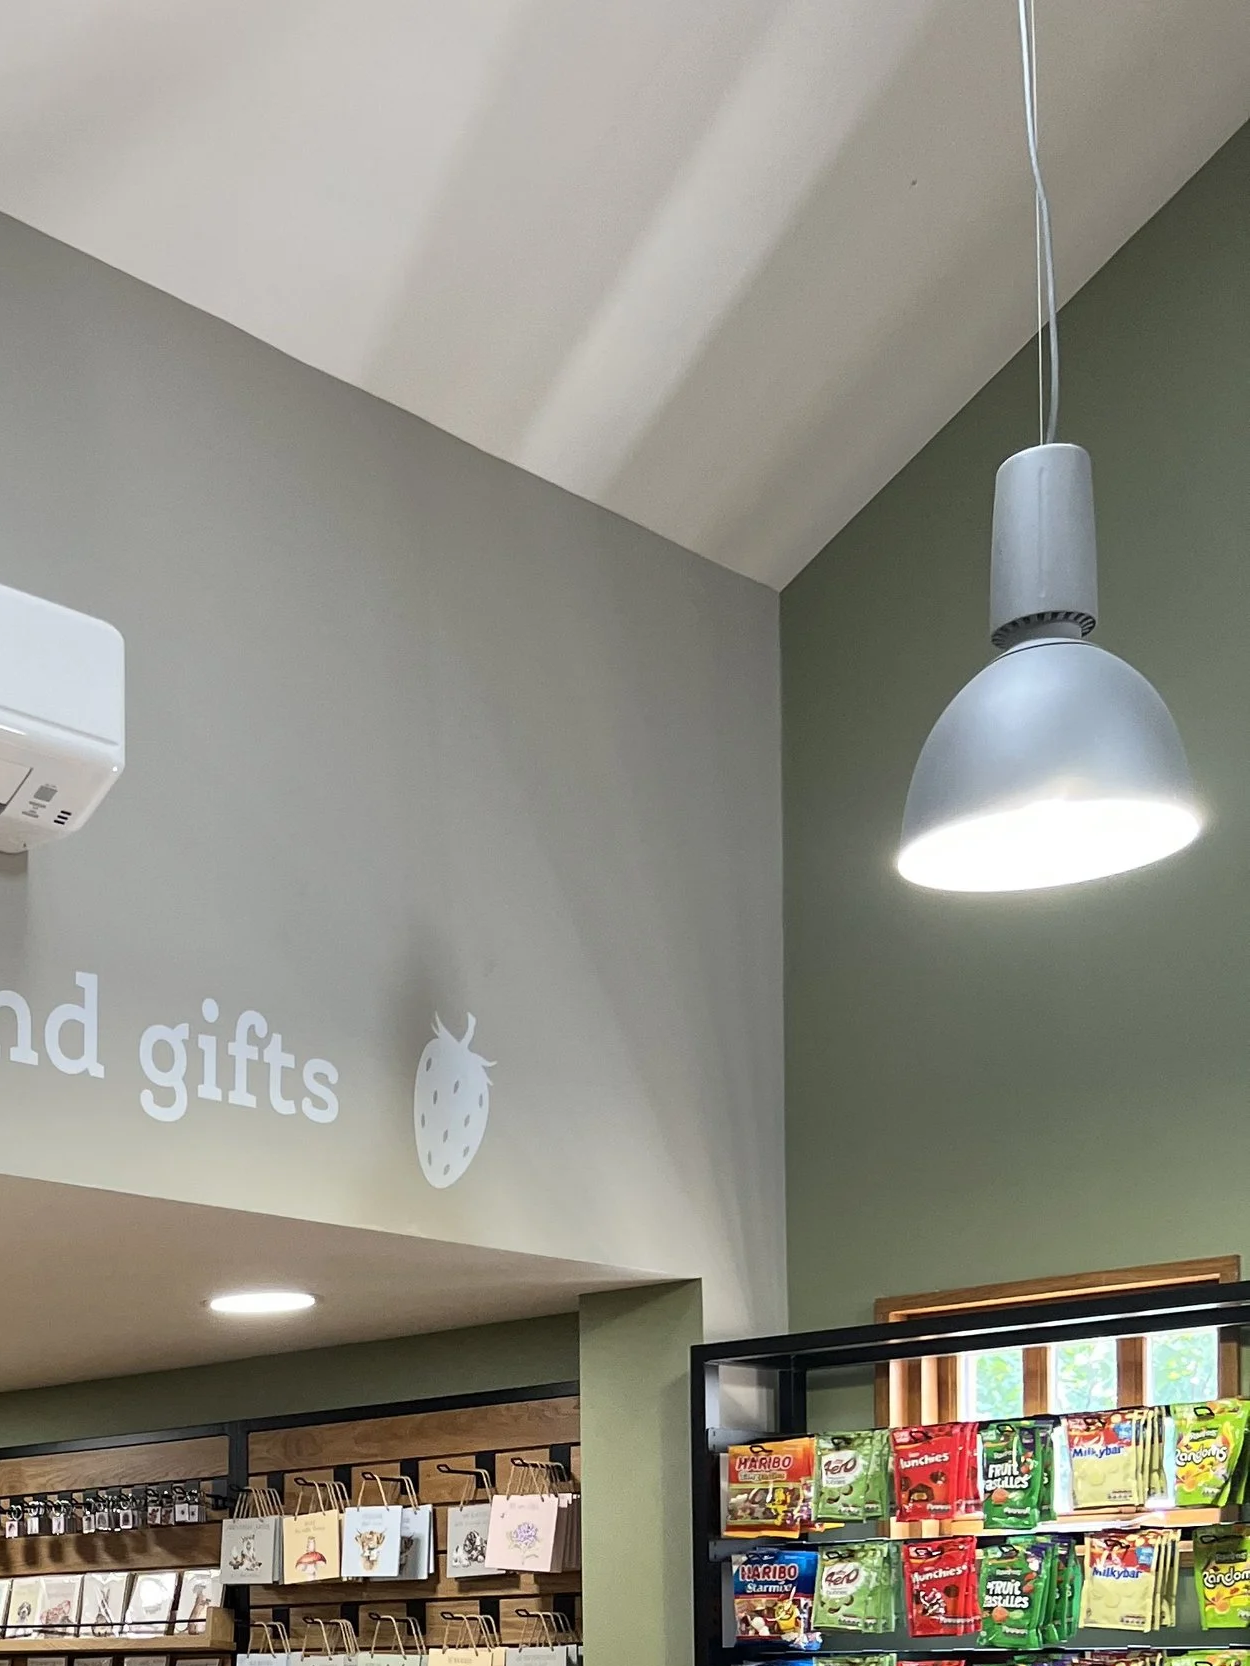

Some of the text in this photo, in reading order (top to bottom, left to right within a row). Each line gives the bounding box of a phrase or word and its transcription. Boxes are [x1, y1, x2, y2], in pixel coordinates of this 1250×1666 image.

[139, 998, 340, 1124] gifts
[735, 1455, 793, 1472] HARIBO
[738, 1563, 799, 1582] HARIBO
[1202, 1566, 1250, 1588] Random
